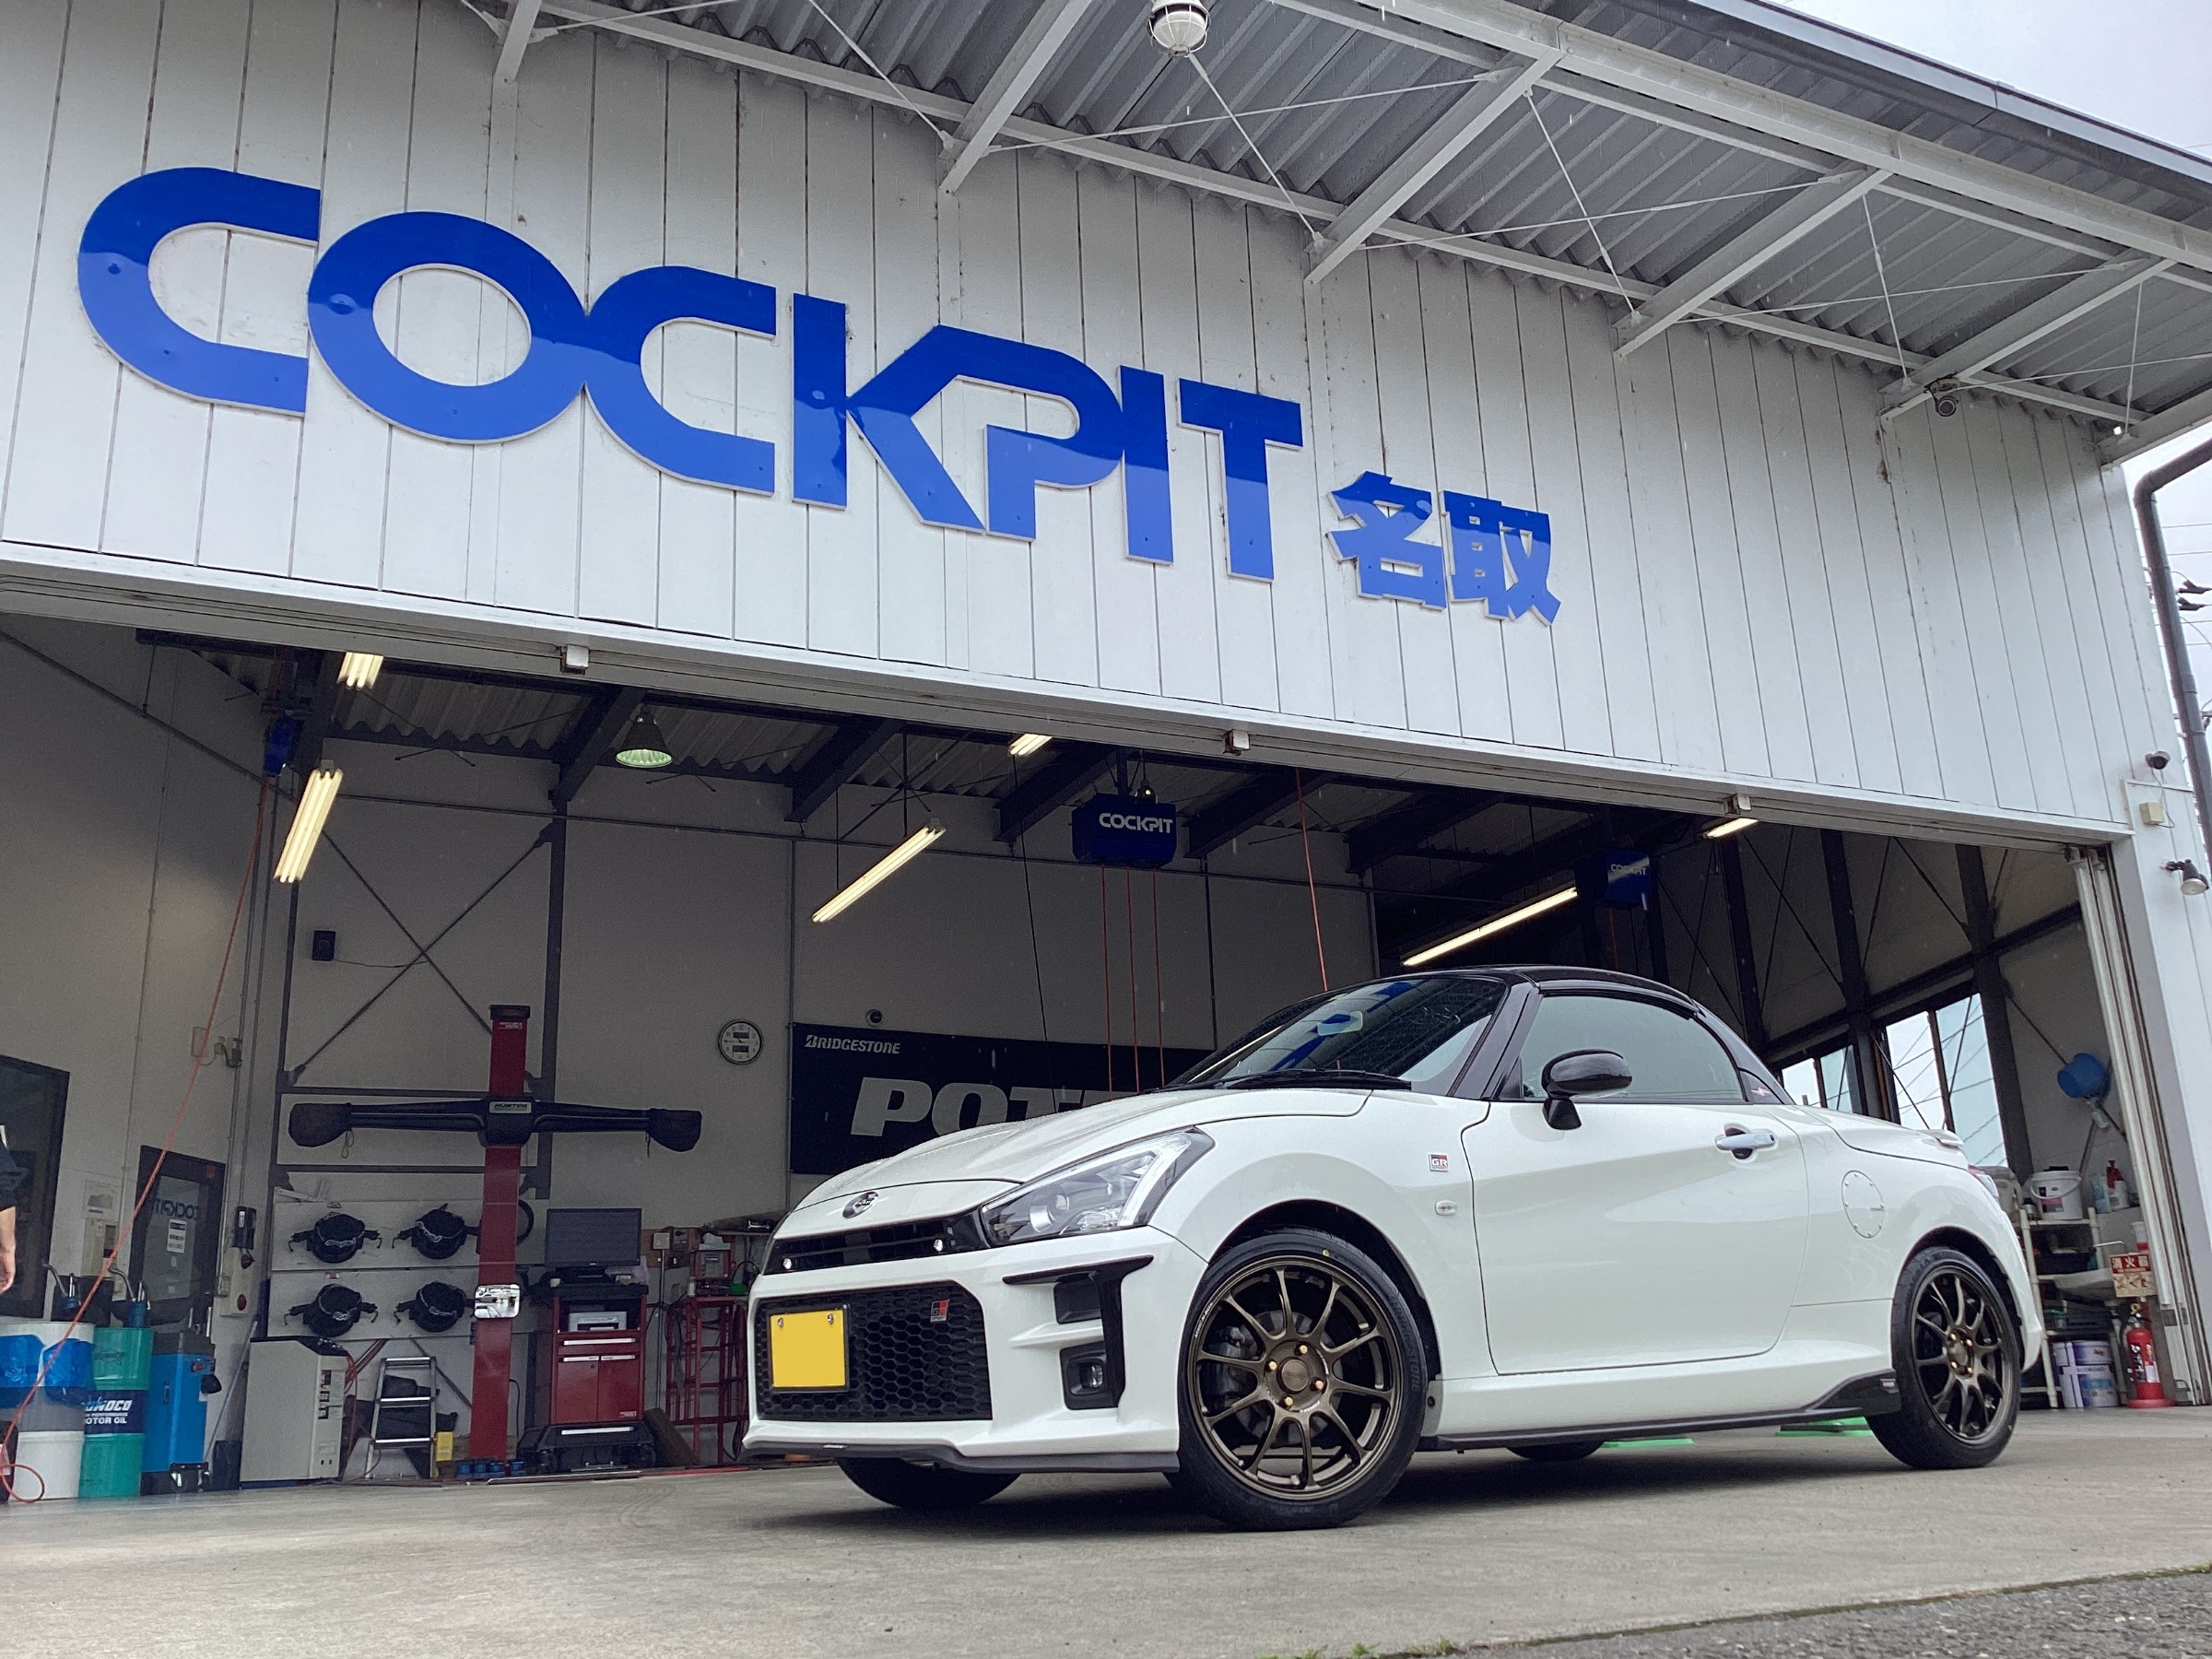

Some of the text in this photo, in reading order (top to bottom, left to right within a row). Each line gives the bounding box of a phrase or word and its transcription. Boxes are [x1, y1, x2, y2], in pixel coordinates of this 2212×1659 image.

[77, 167, 1303, 582] COCKPIT
[1326, 470, 1561, 627] 名取
[1099, 813, 1173, 833] COCKPIT
[805, 1034, 901, 1054] BRIDGESTONE
[1431, 1158, 1448, 1167] GR
